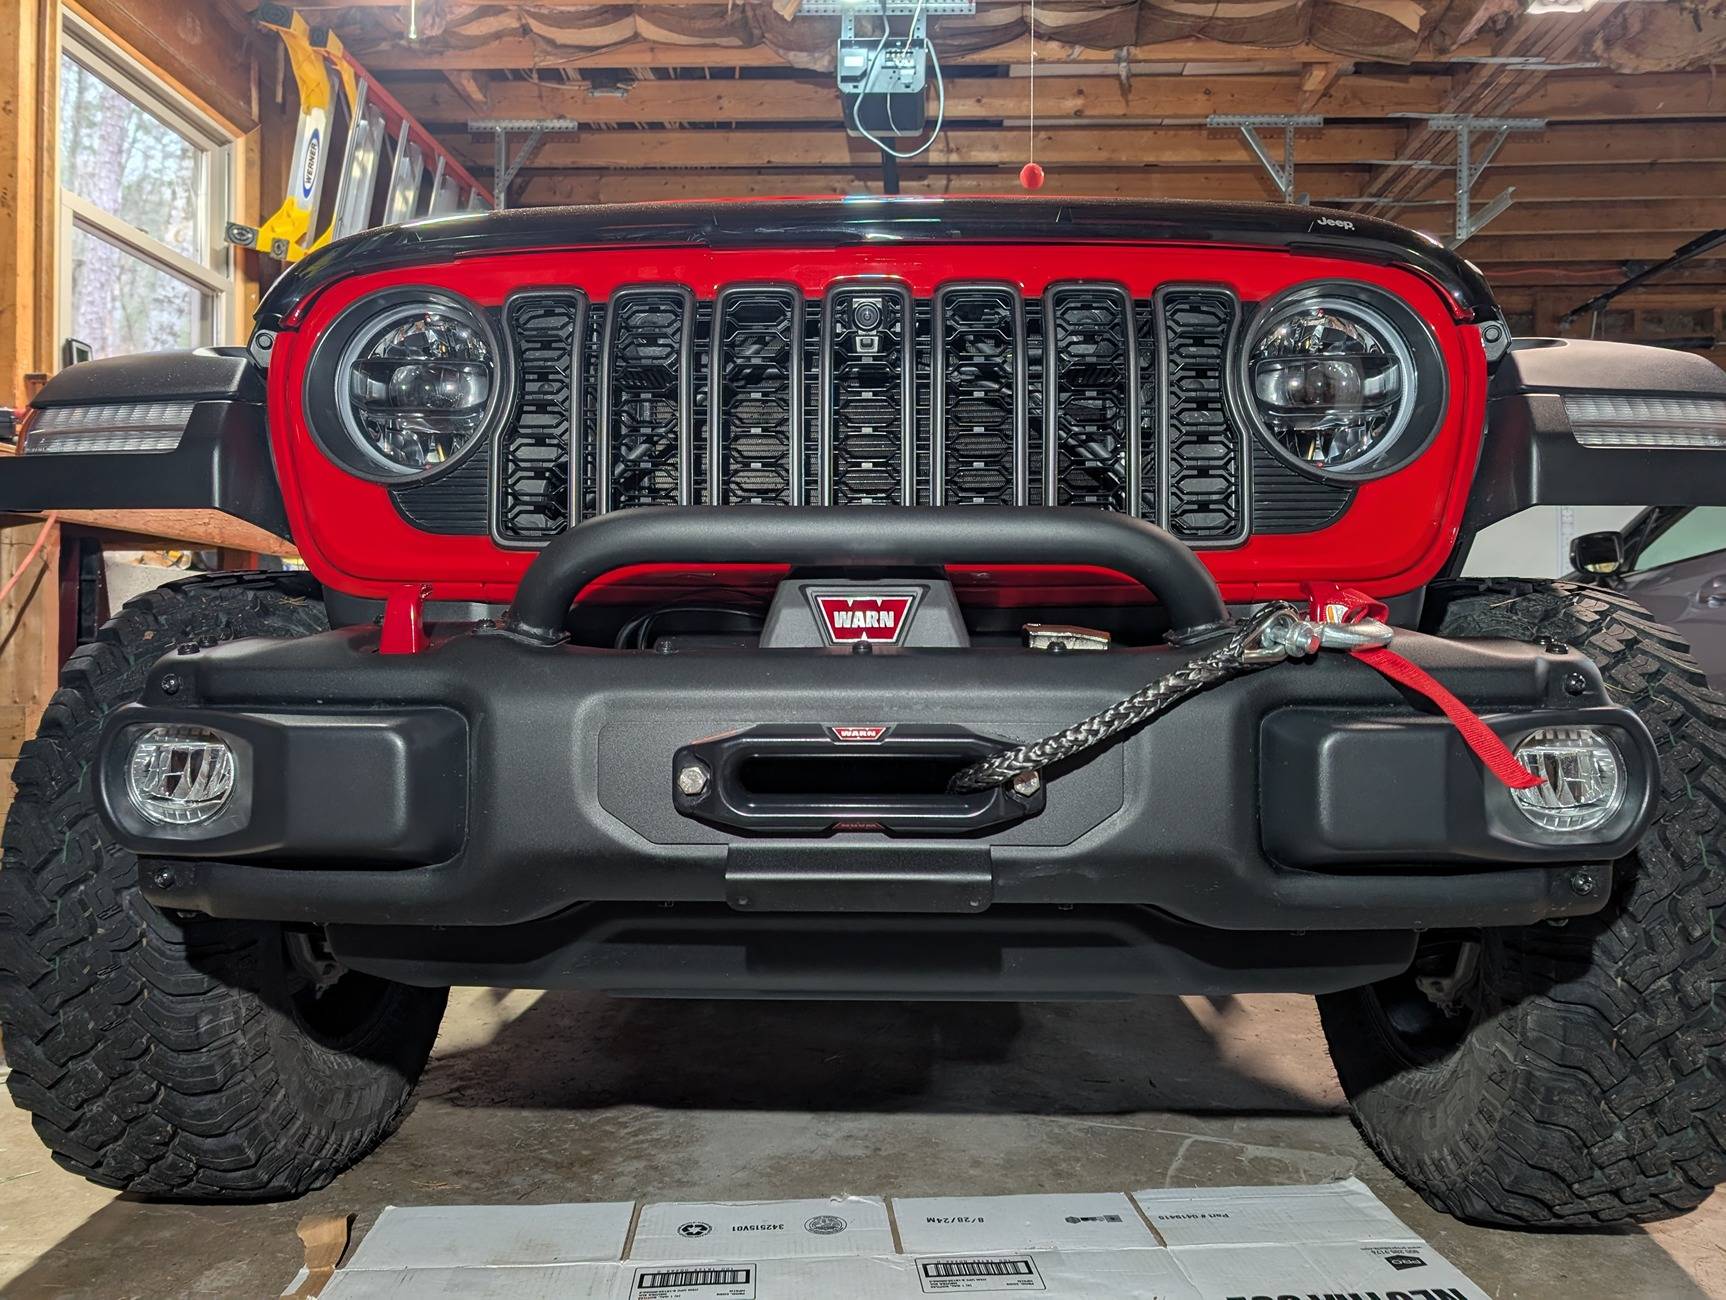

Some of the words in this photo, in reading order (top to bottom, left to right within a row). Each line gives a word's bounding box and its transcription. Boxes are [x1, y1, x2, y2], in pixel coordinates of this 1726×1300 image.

[305, 143, 317, 184] WERNER
[1317, 216, 1353, 230] Jeep
[833, 611, 894, 628] WARN
